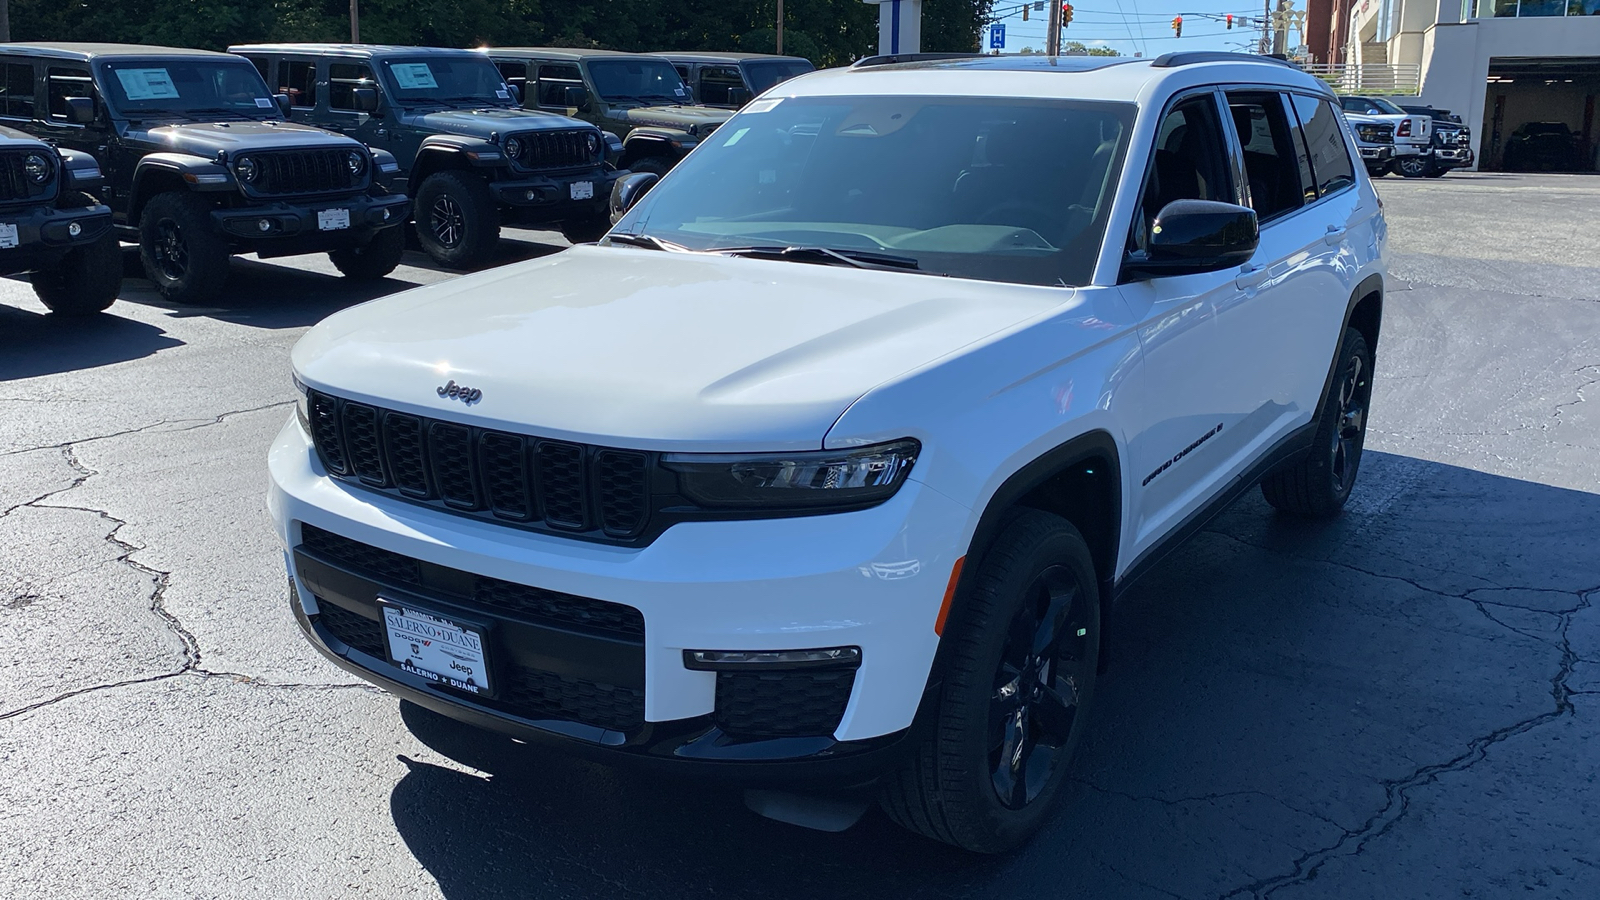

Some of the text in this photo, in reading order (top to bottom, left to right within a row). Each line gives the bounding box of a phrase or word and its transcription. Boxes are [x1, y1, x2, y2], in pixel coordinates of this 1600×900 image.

[994, 29, 1002, 41] H
[437, 380, 482, 404] Jeep
[387, 615, 481, 651] SALERNO DUANE
[400, 663, 479, 694] SALERNO DUANE
[449, 660, 473, 676] Jeep
